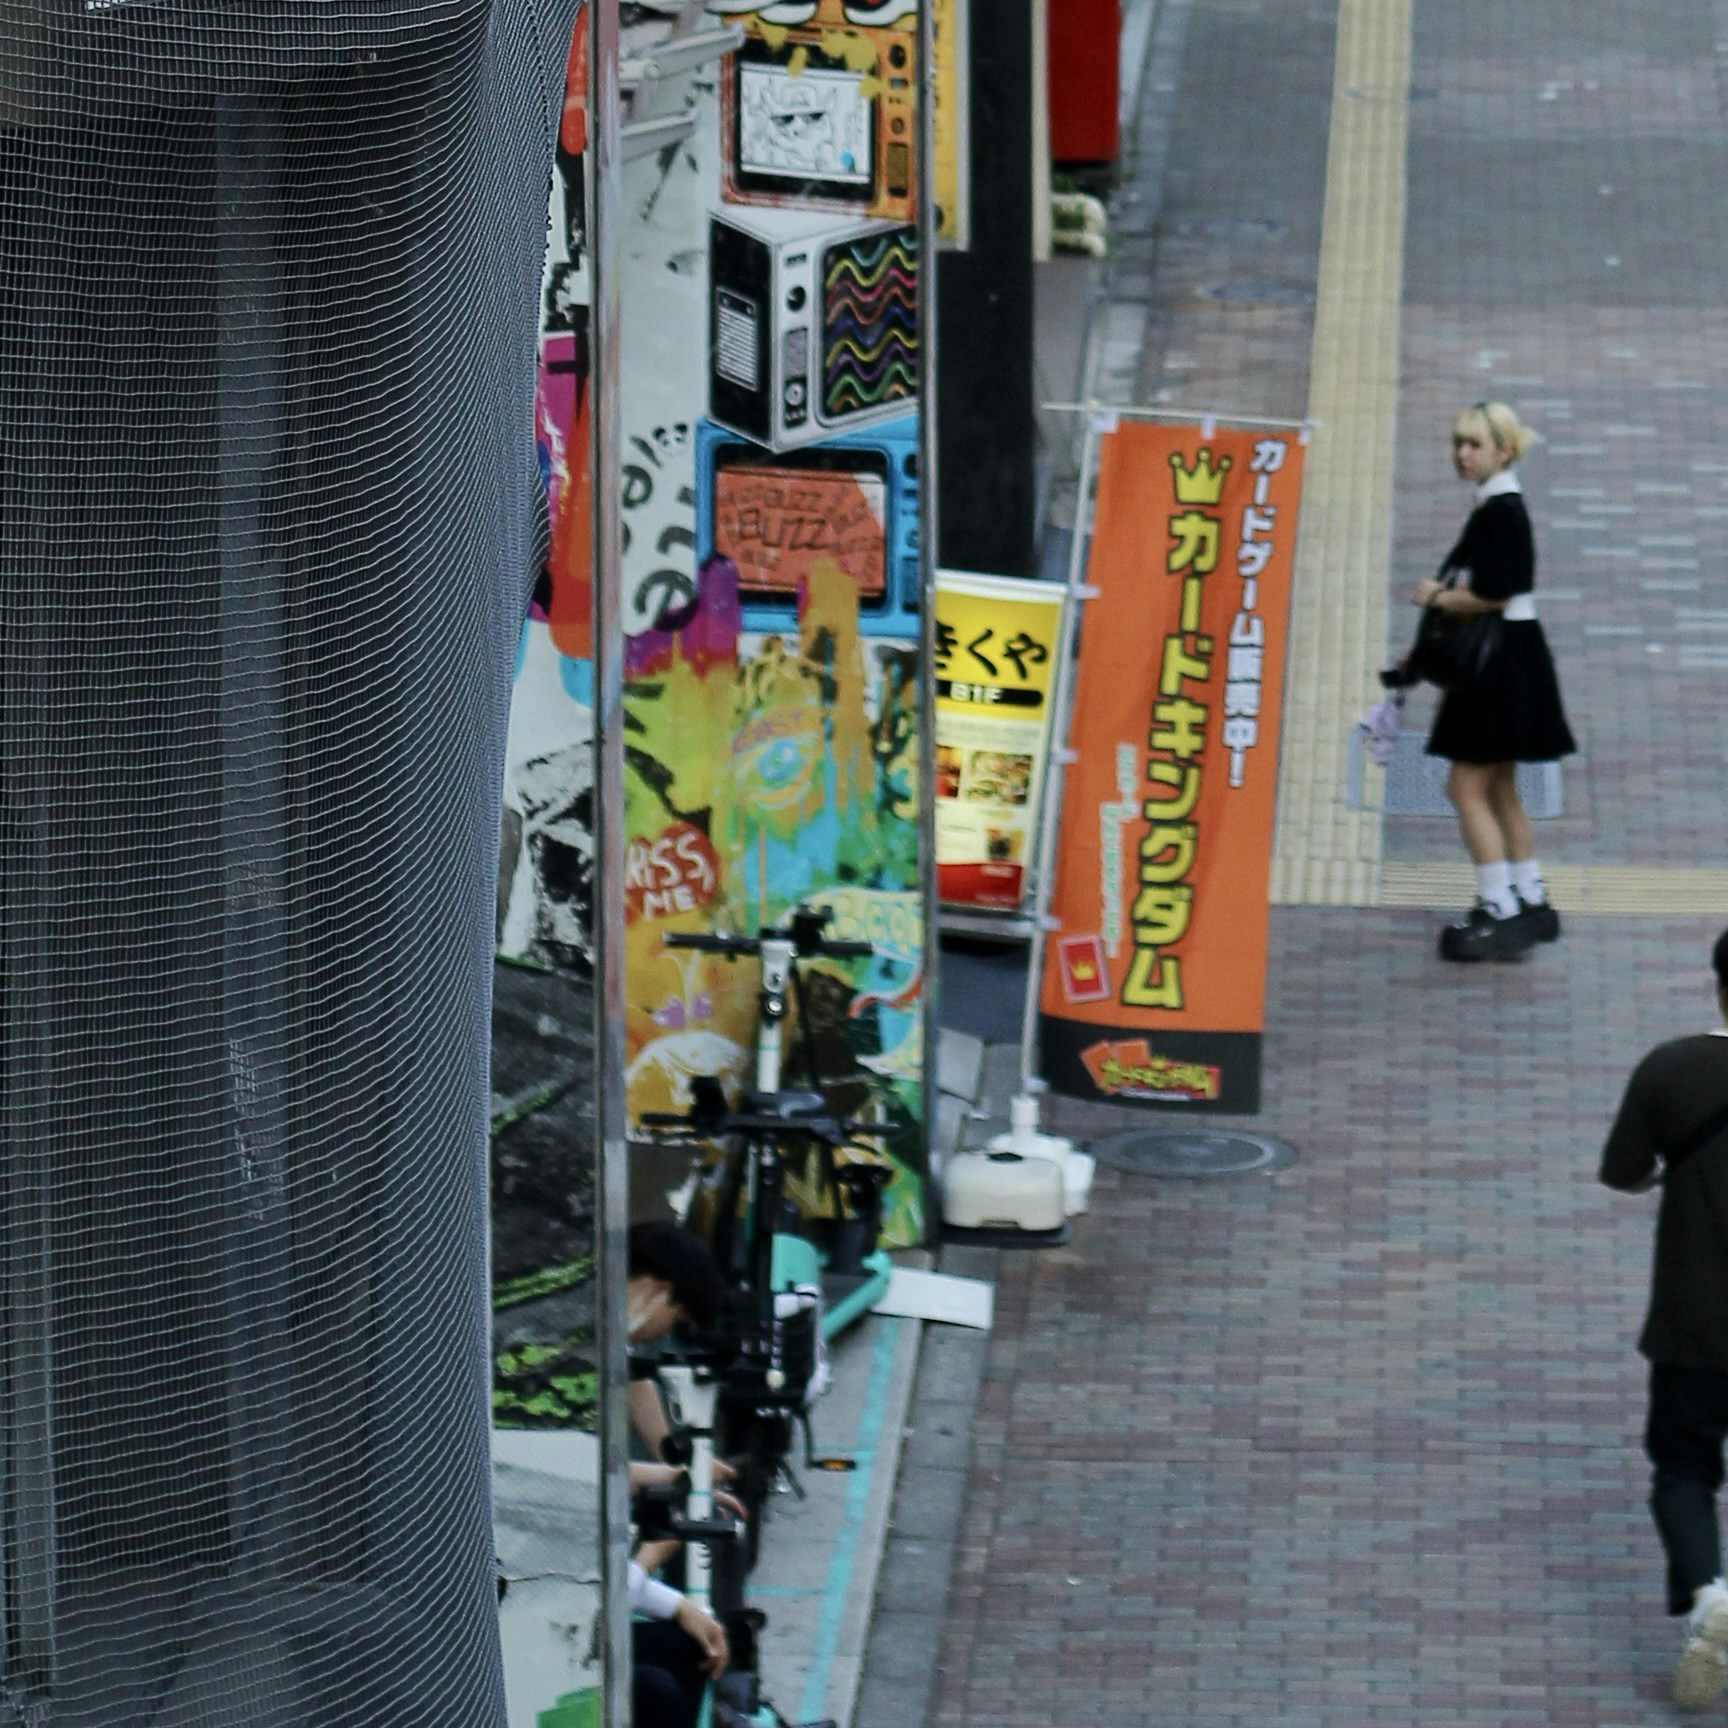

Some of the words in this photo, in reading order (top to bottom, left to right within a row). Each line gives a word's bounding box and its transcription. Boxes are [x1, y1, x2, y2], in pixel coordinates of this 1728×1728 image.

[738, 506, 832, 551] BUZZ
[949, 682, 1002, 703] B1F
[1119, 510, 1222, 1011] カードキングダム
